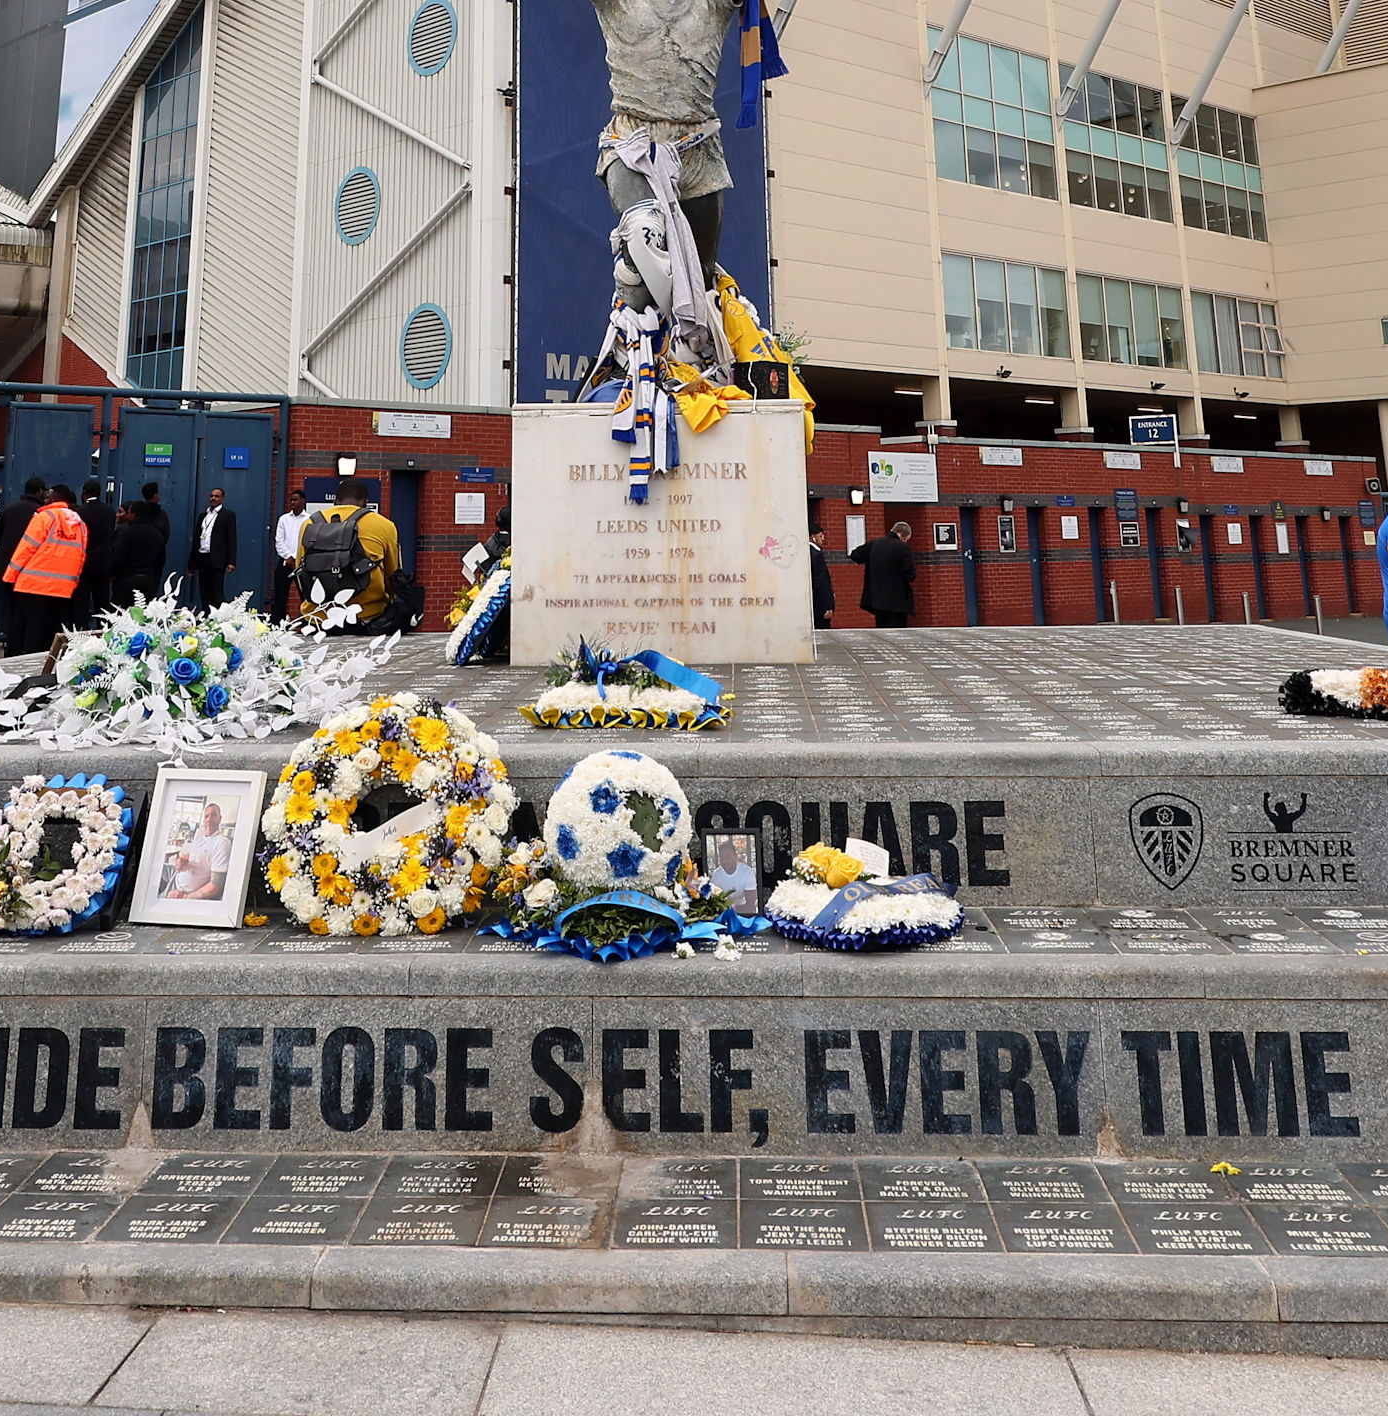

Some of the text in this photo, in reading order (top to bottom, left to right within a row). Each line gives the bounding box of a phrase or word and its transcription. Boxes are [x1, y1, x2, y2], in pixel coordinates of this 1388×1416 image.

[1137, 421, 1168, 429] ENTRANCE
[1148, 428, 1160, 439] 12
[569, 463, 625, 481] BILLY
[667, 494, 693, 506] 1997
[596, 518, 721, 534] LEEDS UNITED
[625, 548, 650, 559] 1959
[669, 547, 695, 559] 1976
[708, 573, 748, 584] GOALS
[545, 597, 775, 609] INSPIRATIONAL CAPTAIN OF THE GREAT
[668, 621, 717, 634] TEAM
[1228, 839, 1355, 858] BREMNER
[1230, 863, 1358, 884] SQUARE
[150, 1025, 493, 1132] BEFORE
[529, 1026, 769, 1147] SELF,
[804, 1028, 1089, 1136] EVERY
[1121, 1030, 1361, 1137] TIME
[1056, 1241, 1114, 1249] FOREVER
[1197, 1242, 1253, 1250] FOREVER
